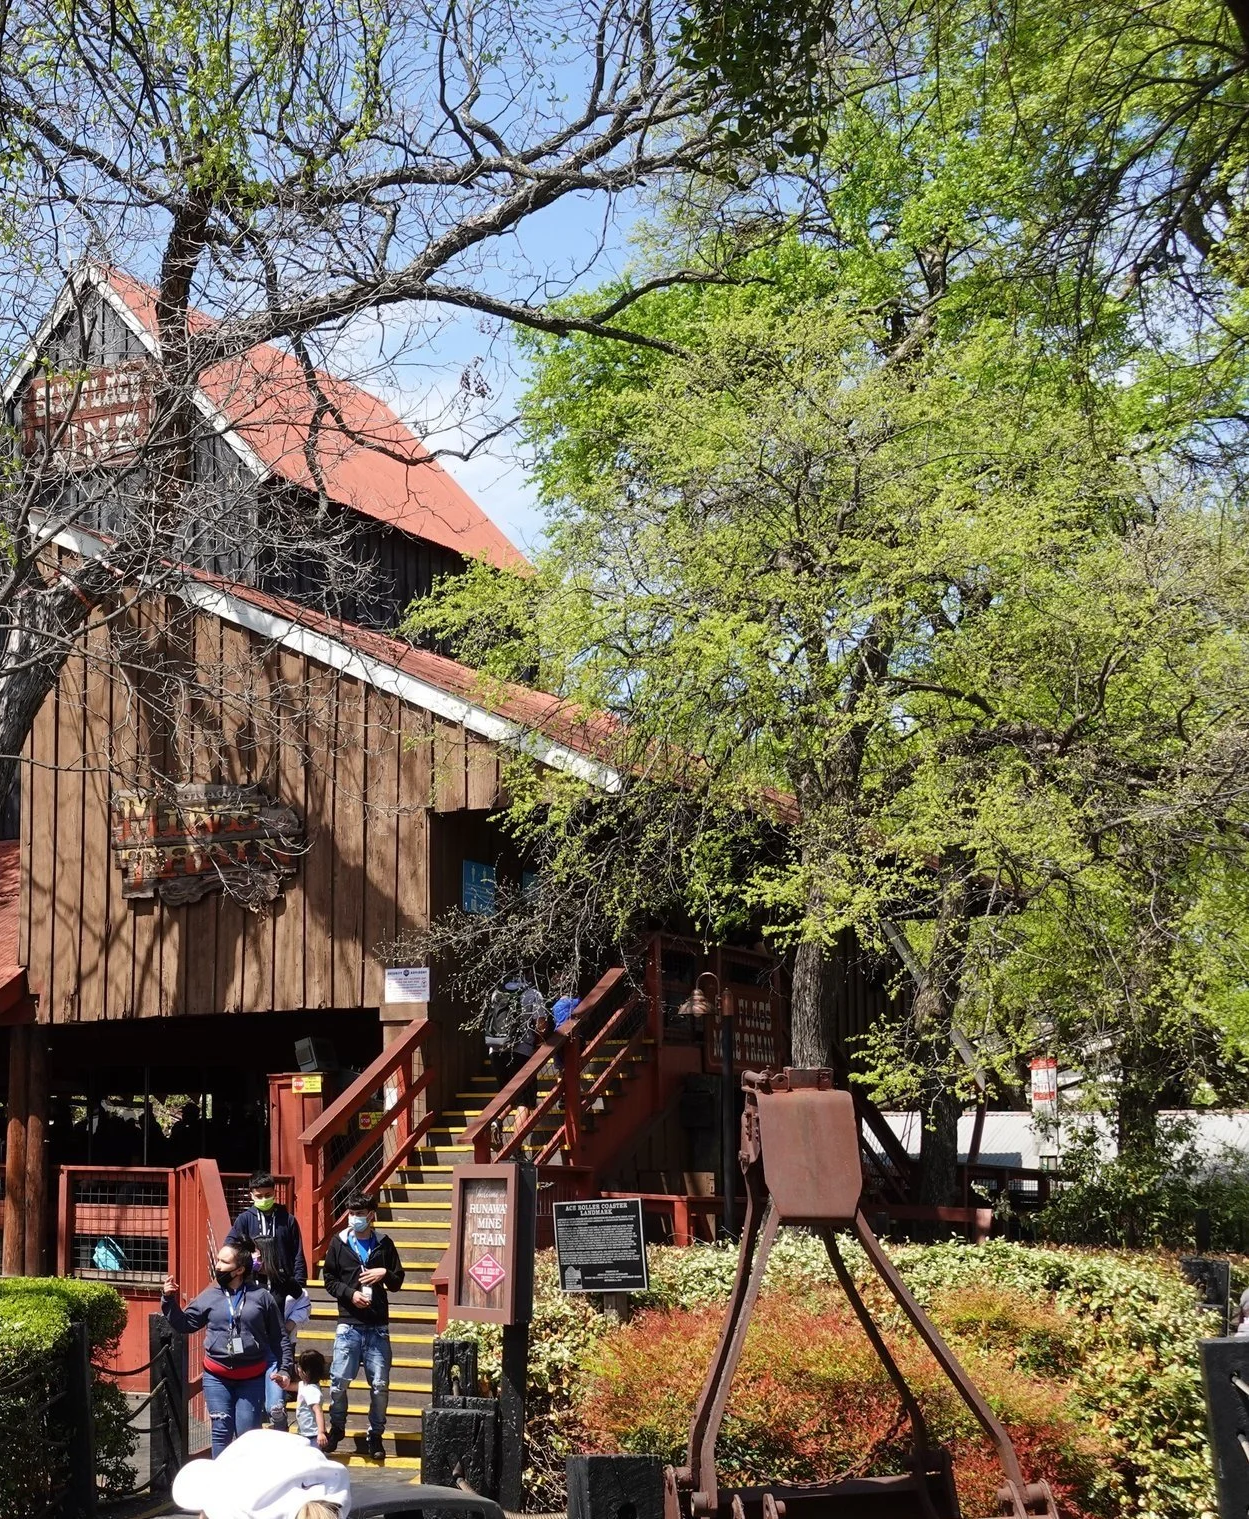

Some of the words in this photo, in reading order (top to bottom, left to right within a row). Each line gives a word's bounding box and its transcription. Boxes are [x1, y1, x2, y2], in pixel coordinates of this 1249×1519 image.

[738, 998, 772, 1031] FLAGS
[743, 1032, 776, 1064] TRAIN
[478, 1218, 502, 1229] MINE
[471, 1233, 506, 1246] TRAIN
